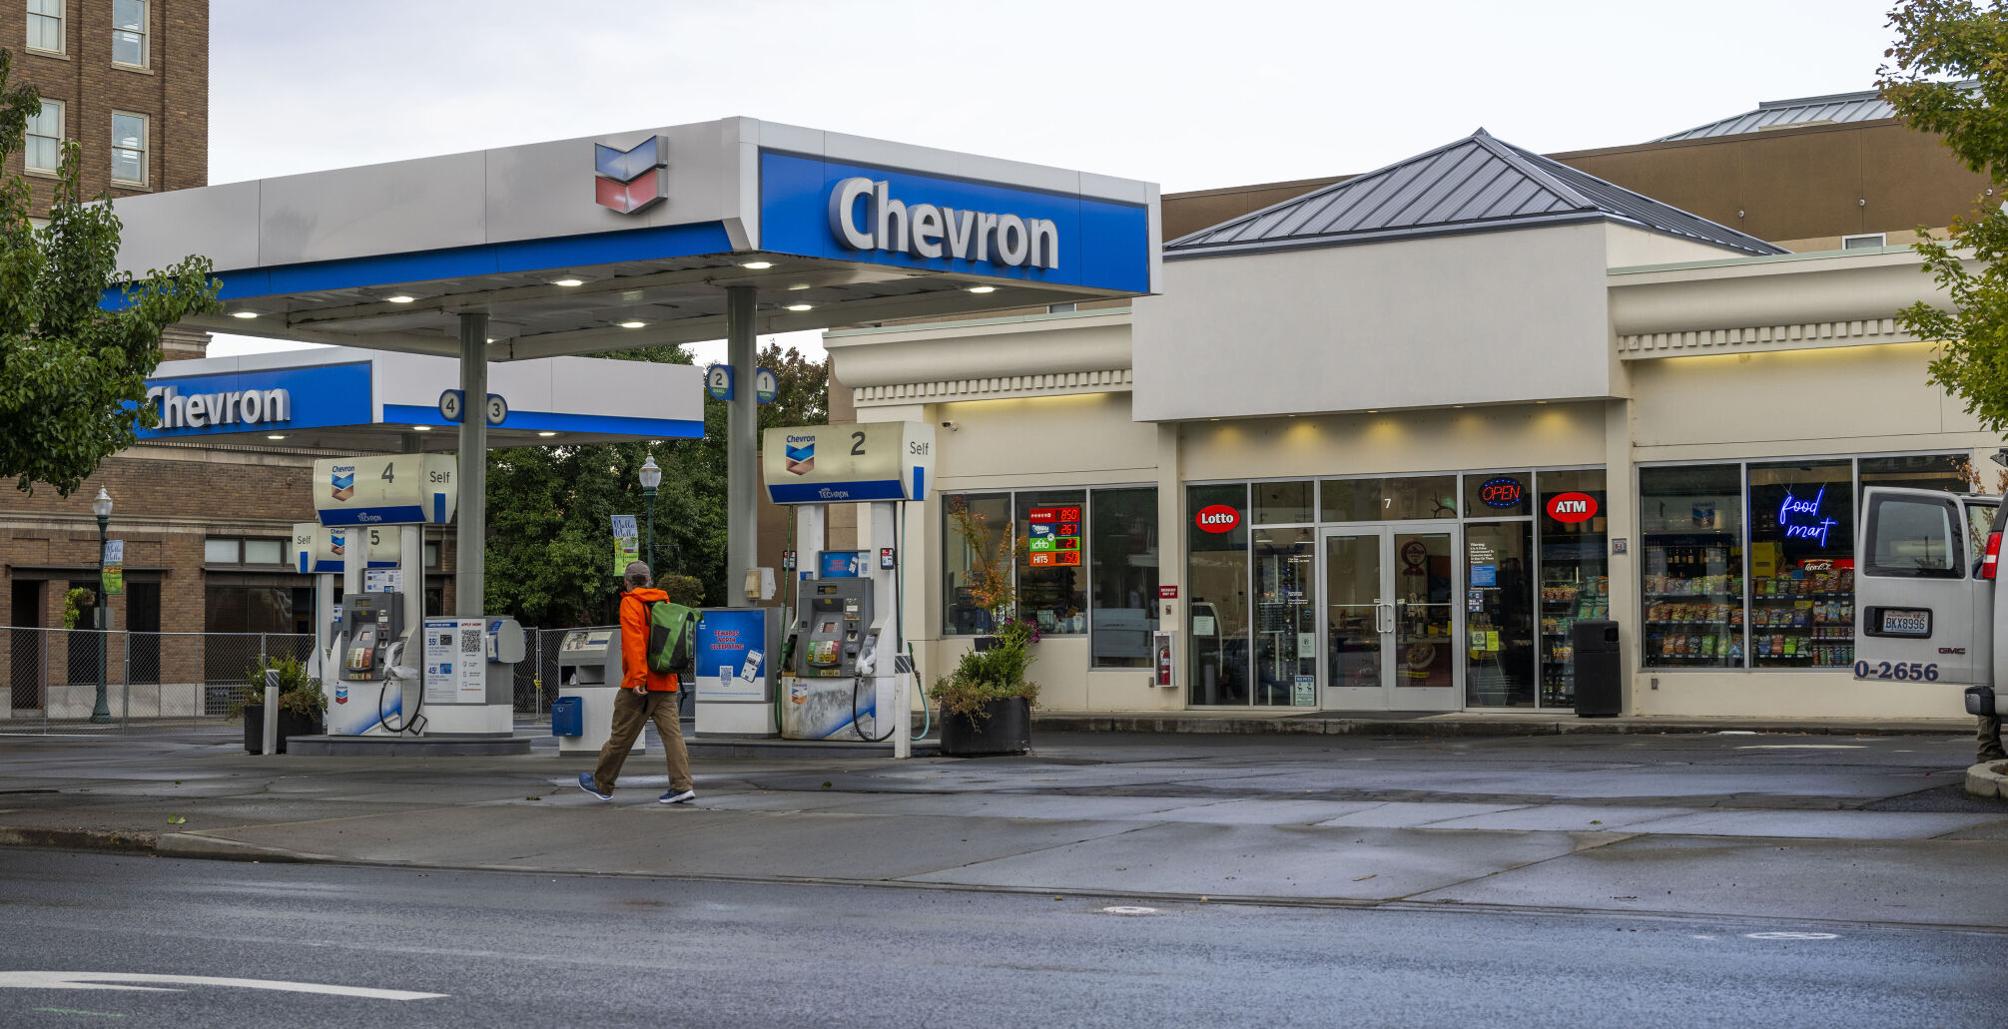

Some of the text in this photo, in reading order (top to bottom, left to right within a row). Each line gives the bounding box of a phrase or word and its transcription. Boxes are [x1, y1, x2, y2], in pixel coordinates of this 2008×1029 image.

[829, 177, 1059, 270] Chevron
[715, 373, 722, 386] 2
[763, 376, 768, 389] 1
[446, 399, 455, 413] 4
[492, 403, 500, 417] 3
[786, 435, 816, 443] Chevron
[850, 431, 866, 456] 2
[910, 441, 929, 456] Self
[331, 465, 355, 473] Chevron
[381, 462, 394, 483] 4
[429, 471, 450, 484] Self
[1482, 485, 1521, 501] OPEN
[1384, 499, 1391, 509] 7
[1555, 501, 1587, 513] ATM
[1780, 488, 1825, 525] food
[1201, 512, 1234, 525] Lotto
[370, 530, 380, 545] 5
[1786, 517, 1838, 548] mart
[296, 535, 311, 545] Self
[1885, 618, 1925, 630] BKX8996
[1855, 660, 1939, 681] 0-2656
